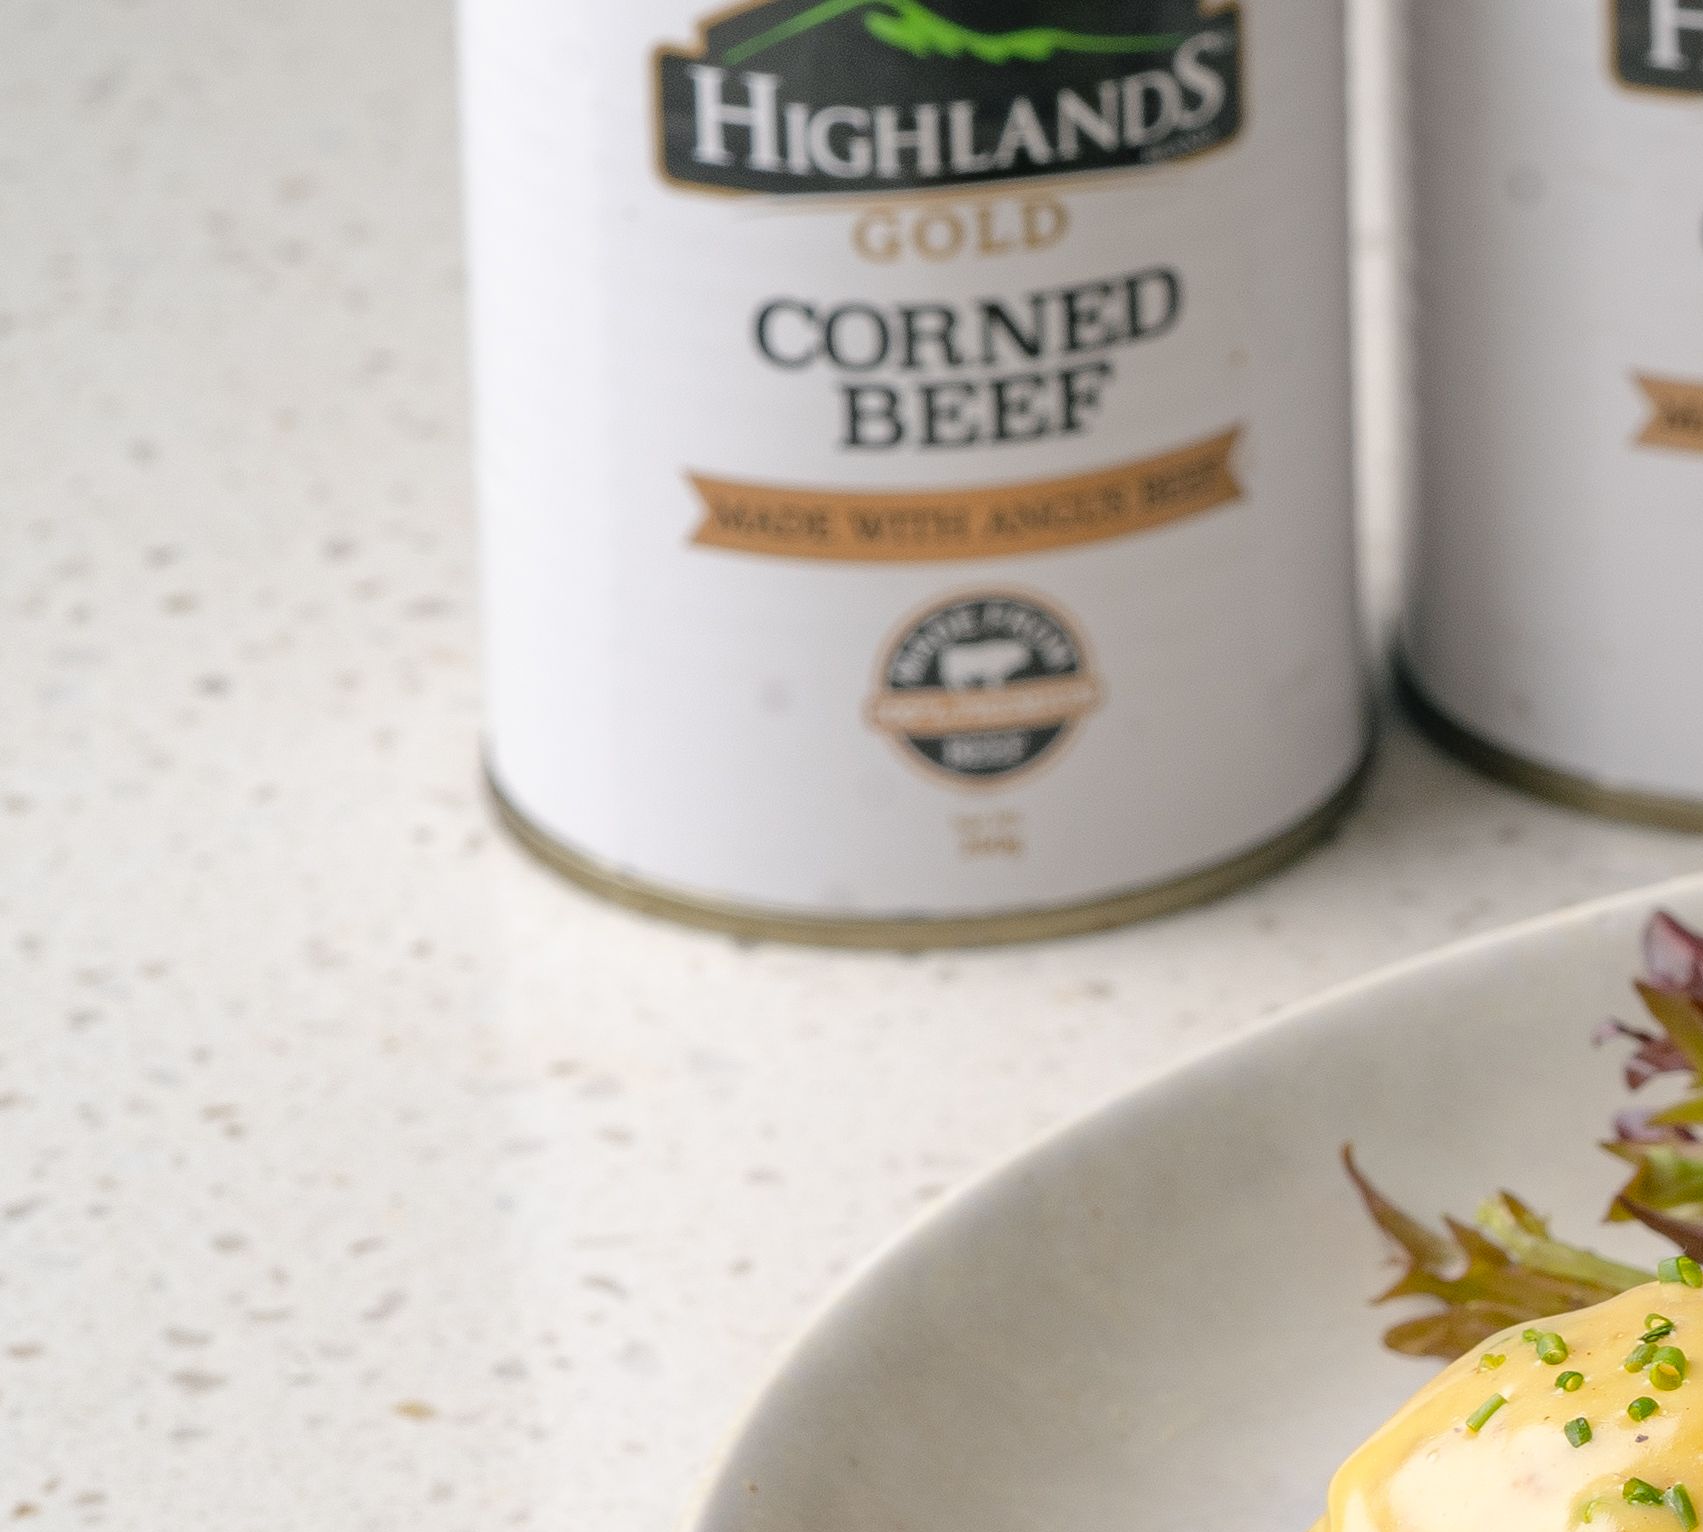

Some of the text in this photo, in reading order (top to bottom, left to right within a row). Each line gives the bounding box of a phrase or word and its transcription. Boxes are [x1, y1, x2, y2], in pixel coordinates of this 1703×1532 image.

[688, 29, 1228, 180] HIGHLANDS
[850, 193, 1070, 264] GOLD
[753, 264, 1182, 370] CORNED
[840, 362, 1115, 450] BEEF
